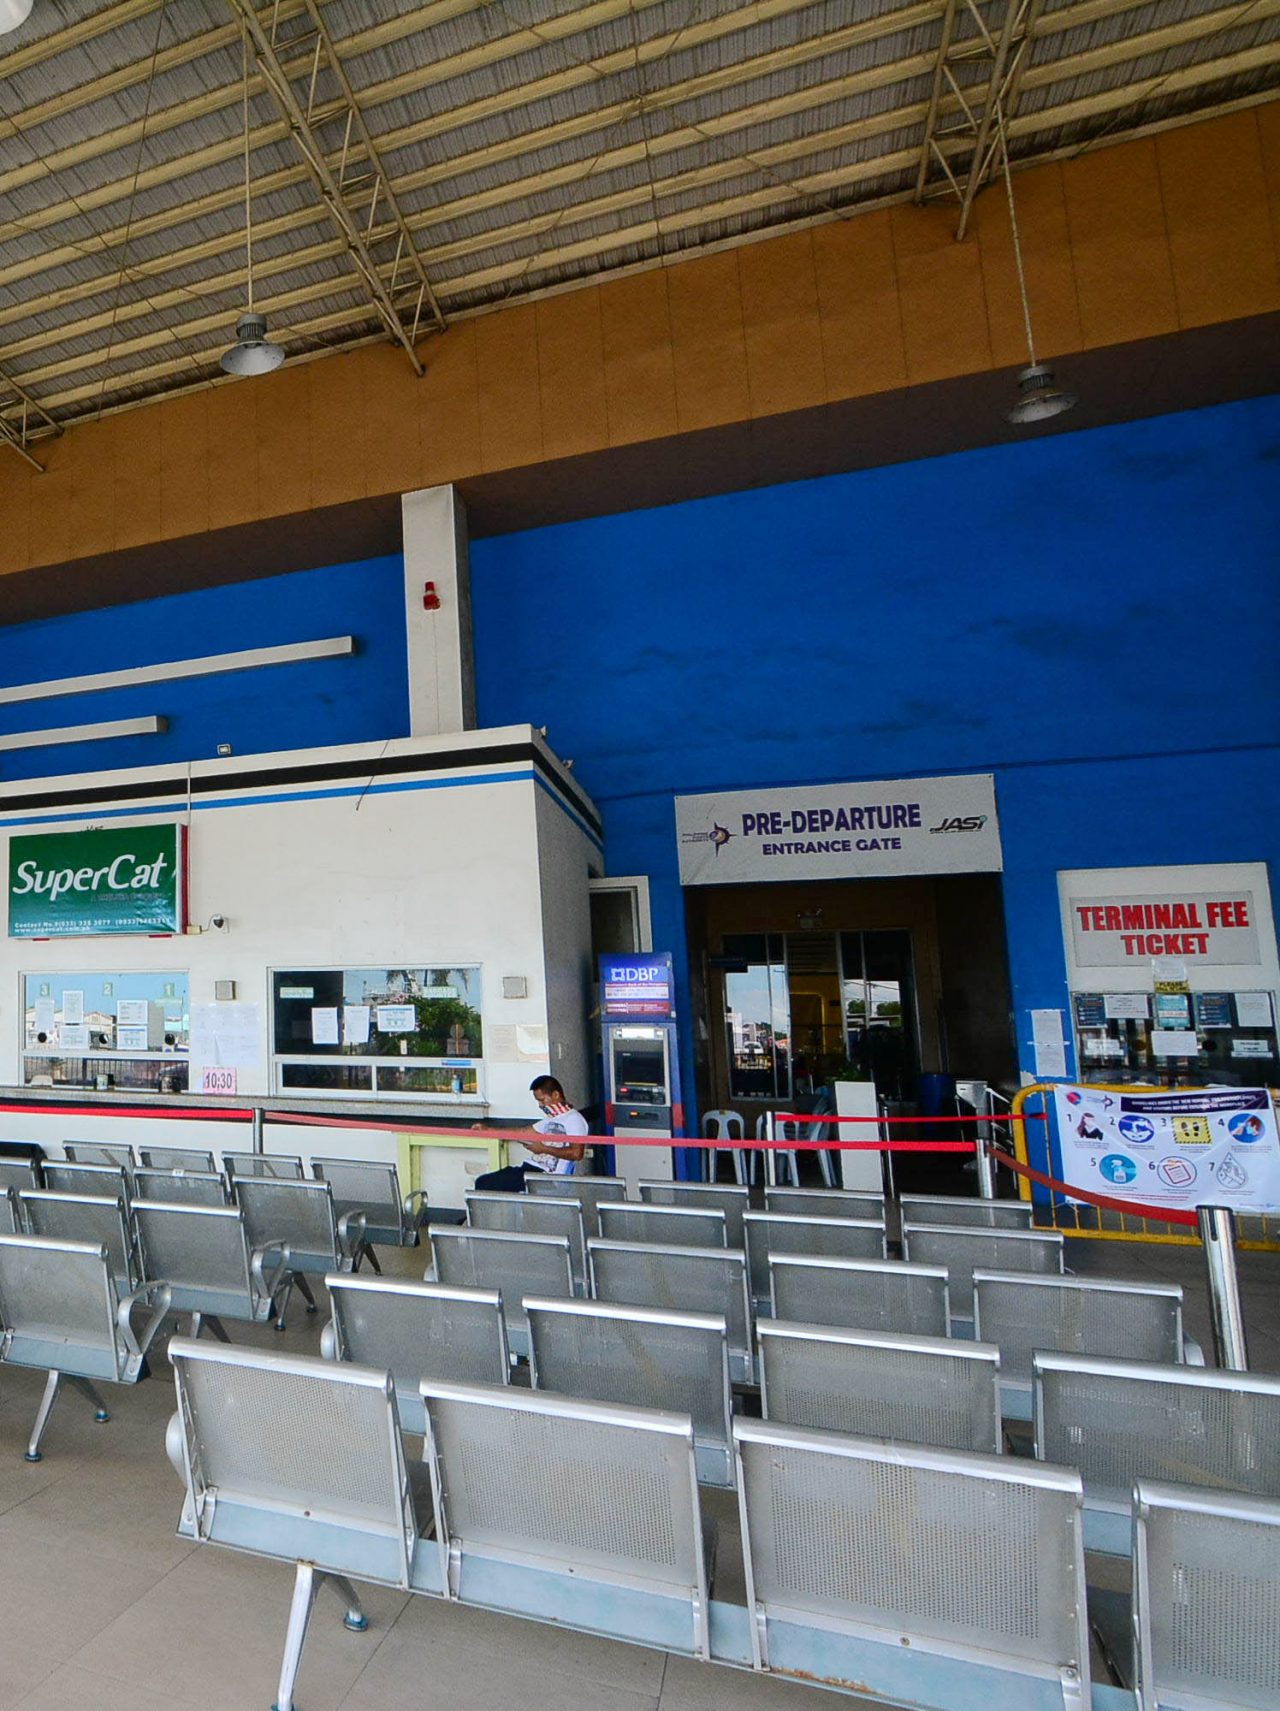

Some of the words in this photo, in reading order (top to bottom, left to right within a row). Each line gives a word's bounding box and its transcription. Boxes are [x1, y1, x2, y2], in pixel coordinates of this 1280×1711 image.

[742, 804, 921, 836] PRE-DEPARTURE
[762, 838, 851, 855] ENTRANCE
[856, 836, 902, 850] GATE
[12, 852, 167, 901] SuperCat
[1076, 903, 1202, 931] TERMINAL
[1206, 901, 1249, 928] FEE
[1120, 933, 1209, 955] TICKET
[626, 968, 658, 981] DBP
[103, 984, 111, 995] 2
[1067, 1114, 1072, 1123] 1
[1109, 1116, 1116, 1126] 2
[1160, 1118, 1167, 1127] 3
[1217, 1118, 1225, 1127] 4
[1090, 1157, 1097, 1167] 5
[1148, 1161, 1156, 1171] 6
[1209, 1162, 1216, 1172] 7
